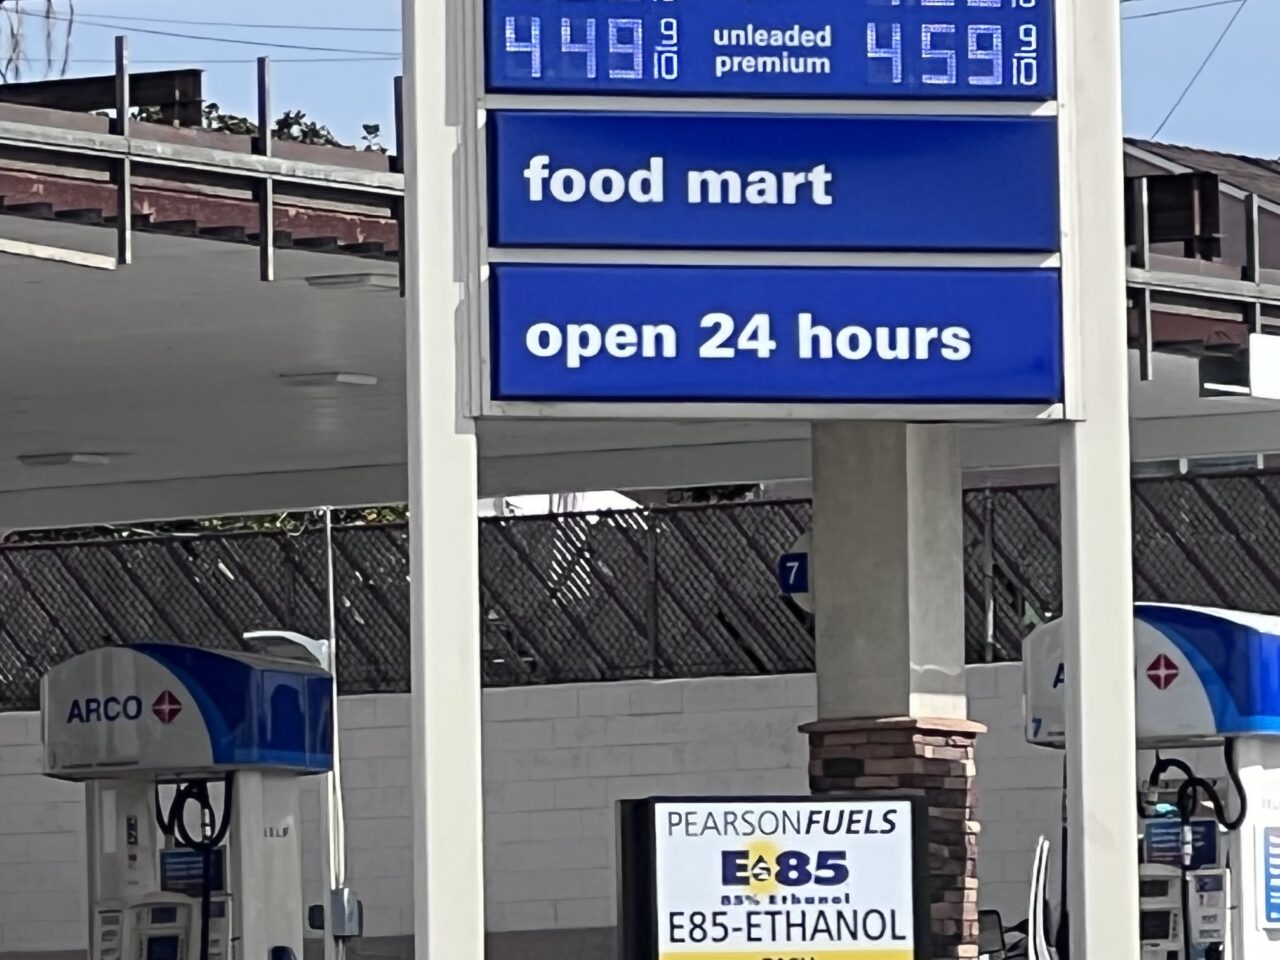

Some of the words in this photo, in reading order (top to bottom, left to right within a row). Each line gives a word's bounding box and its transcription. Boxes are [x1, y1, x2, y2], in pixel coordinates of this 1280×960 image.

[714, 24, 831, 48] unleaded
[715, 51, 831, 75] premium
[523, 154, 664, 203] food
[687, 162, 833, 205] mart
[525, 319, 677, 368] open
[699, 312, 777, 358] 24
[797, 312, 972, 360] hours
[786, 562, 800, 585] 7
[66, 695, 143, 724] ARCO
[1031, 717, 1043, 738] 7
[668, 908, 908, 943] E85-ETHANOL
